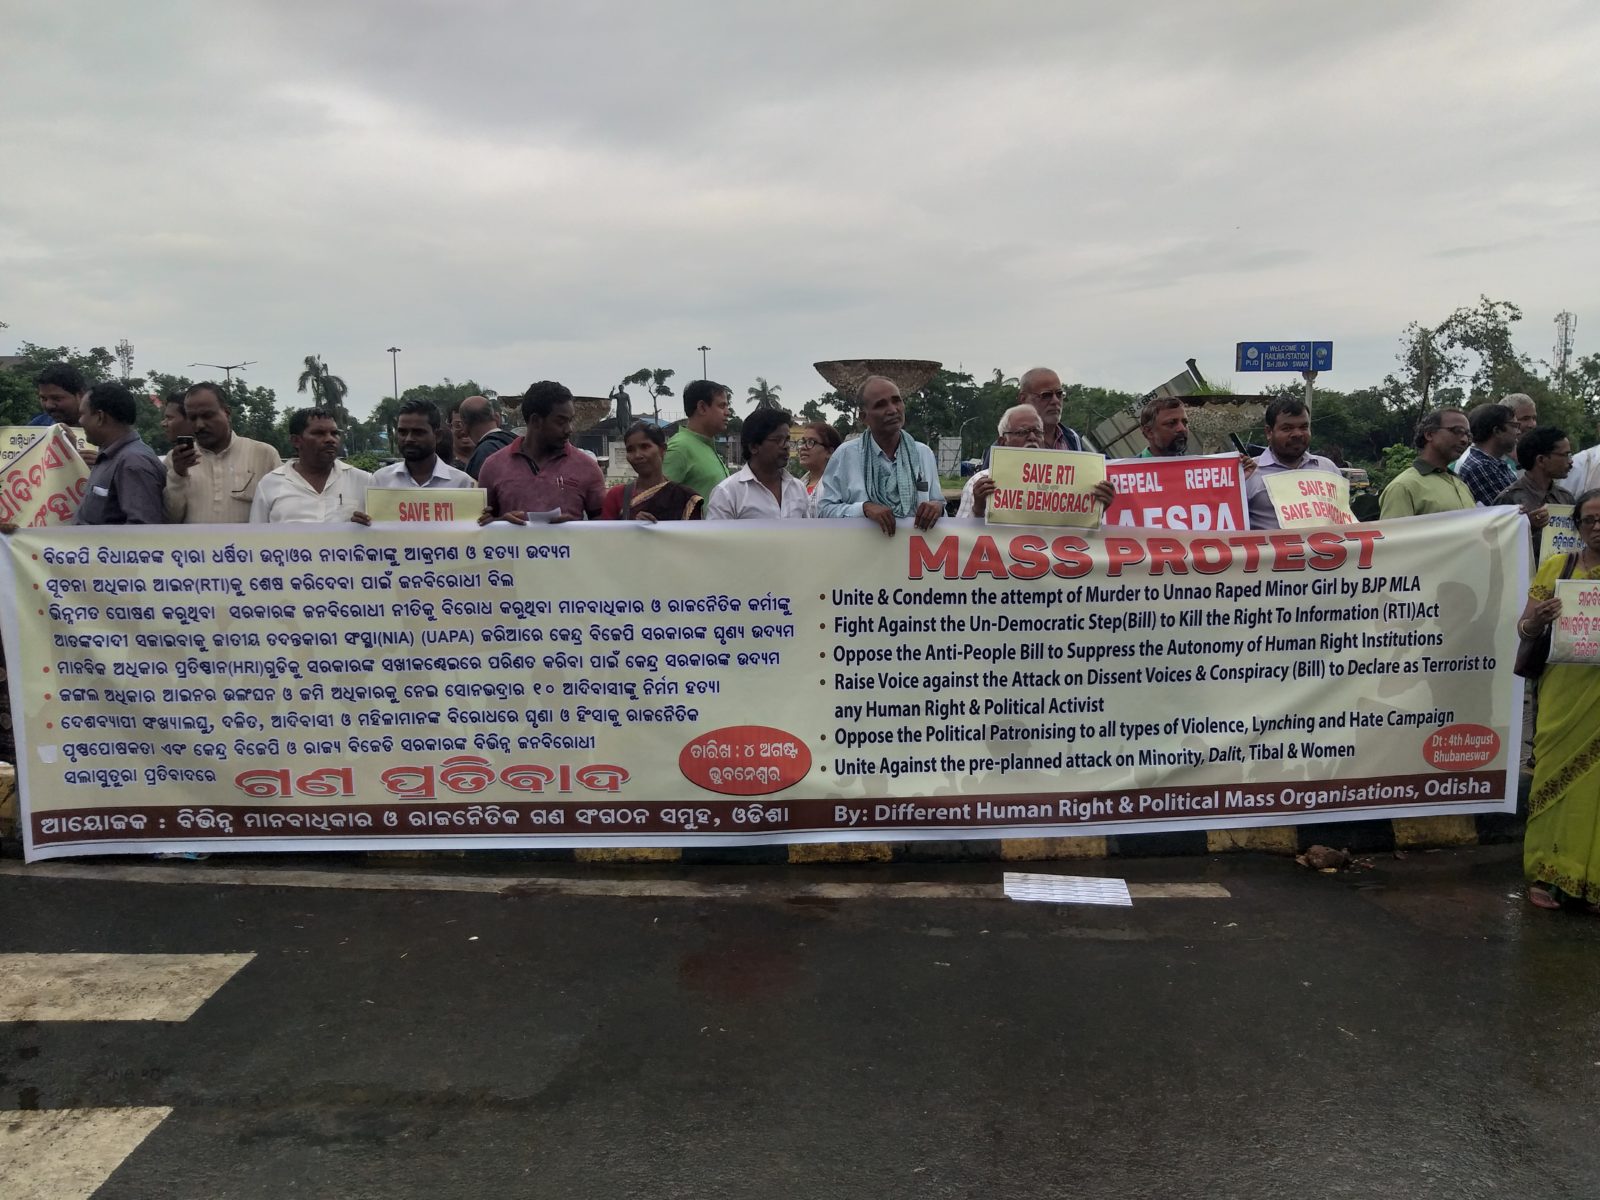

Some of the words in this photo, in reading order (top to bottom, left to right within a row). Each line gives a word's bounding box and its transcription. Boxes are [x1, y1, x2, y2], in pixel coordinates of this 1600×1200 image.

[1287, 352, 1310, 360] STATION
[1022, 462, 1053, 484] SAVE
[1056, 464, 1075, 485] RTI
[1110, 472, 1163, 495] REPEAL
[1185, 467, 1235, 490] REPEAL
[993, 488, 1024, 510] SAVE
[1026, 491, 1097, 513] DEMOCRACY
[1297, 480, 1327, 497] SAVE
[1325, 481, 1338, 500] RTI
[399, 502, 431, 521] SAVE
[434, 502, 454, 521] RTI
[1281, 502, 1312, 521] SAVE
[466, 545, 476, 560] ଓ
[908, 535, 1094, 580] MASS
[1104, 530, 1385, 577] PROTEST
[832, 588, 874, 606] Unite
[877, 588, 889, 605] &
[893, 587, 967, 605] Condemn
[971, 587, 997, 605] the
[1001, 588, 1063, 608] attempt
[1066, 585, 1083, 603] of
[1085, 584, 1141, 603] Murder
[1144, 585, 1160, 601] to
[1164, 584, 1212, 600] Unnao
[1215, 580, 1262, 602] Raped
[1265, 580, 1308, 597] Minor
[1311, 578, 1337, 595] Girl
[1341, 577, 1359, 598] by
[1362, 577, 1387, 594] BJP
[1389, 575, 1421, 592] MLA
[835, 616, 874, 637] Fight
[877, 615, 936, 637] Against
[940, 615, 966, 632] the
[970, 613, 1085, 632] Un-Democratic
[1088, 611, 1156, 633] Step(Bill)
[1160, 613, 1176, 628] to
[1179, 609, 1202, 627] Kill
[1206, 609, 1230, 626] the
[1234, 607, 1273, 629] Right
[1275, 607, 1292, 623] To
[1295, 604, 1379, 623] Information
[1383, 602, 1439, 622] (RTI)Act
[833, 645, 892, 666] Oppose
[896, 644, 921, 661] the
[925, 643, 1016, 664] Anti-People
[1020, 642, 1044, 660] Bill
[1047, 644, 1063, 659] to
[1067, 642, 1135, 662] Suppress
[1139, 639, 1163, 656] the
[1166, 639, 1244, 657] Autonomy
[1247, 635, 1263, 652] of
[1265, 636, 1316, 652] Human
[1320, 632, 1358, 653] Right
[1362, 630, 1443, 648] Institutions
[835, 673, 875, 690] Raise
[878, 672, 919, 689] Voice
[923, 671, 979, 692] against
[982, 670, 1008, 687] the
[1011, 669, 1061, 687] Attack
[1064, 673, 1083, 686] on
[1087, 668, 1142, 685] Dissent
[1145, 666, 1192, 683] Voices
[1195, 665, 1207, 681] &
[1210, 662, 1289, 683] Conspiracy
[1293, 660, 1325, 680] (Bill)
[1329, 661, 1344, 676] to
[1347, 658, 1400, 676] Declare
[1403, 661, 1419, 673] as
[1422, 655, 1480, 673] Terrorist
[1483, 656, 1496, 670] to
[834, 705, 863, 723] any
[866, 701, 920, 717] Human
[925, 699, 966, 720] Right
[969, 699, 980, 715] &
[984, 697, 1045, 715] Political
[1048, 696, 1104, 714] Activist
[835, 728, 894, 749] Oppose
[897, 726, 922, 743] the
[926, 724, 986, 742] Political
[990, 723, 1076, 743] Patronising
[1079, 723, 1095, 738] to
[1099, 720, 1116, 738] all
[1119, 722, 1160, 741] types
[1163, 717, 1179, 735] of
[1181, 716, 1248, 735] Violence,
[1252, 713, 1315, 736] Lynching
[1318, 711, 1346, 728] and
[1350, 711, 1384, 727] Hate
[1387, 708, 1455, 729] Campaign
[1432, 734, 1443, 747] Dt
[1448, 733, 1463, 746] 4th
[1464, 733, 1494, 748] August
[835, 757, 876, 776] Unite
[879, 756, 937, 778] Against
[940, 754, 965, 772] the
[969, 752, 1062, 775] pre-planned
[1066, 750, 1112, 768] attack
[1115, 754, 1134, 767] on
[1139, 748, 1205, 768] Minority,
[1208, 745, 1245, 763] Dalit,
[1249, 742, 1284, 760] Tibal
[1287, 743, 1298, 759] &
[1301, 742, 1355, 758] Women
[1433, 749, 1490, 763] Bhubaneswar
[234, 767, 356, 798] ଗଣ
[835, 806, 867, 825] By:
[875, 803, 971, 820] Different
[977, 802, 1052, 819] Human
[1059, 798, 1113, 820] Right
[1119, 796, 1133, 813] &
[1139, 791, 1219, 812] Political
[1225, 791, 1274, 807] Mass
[1280, 783, 1419, 808] Organisations,
[1425, 777, 1490, 796] Odisha
[159, 818, 165, 829] :
[383, 811, 398, 826] ଓ
